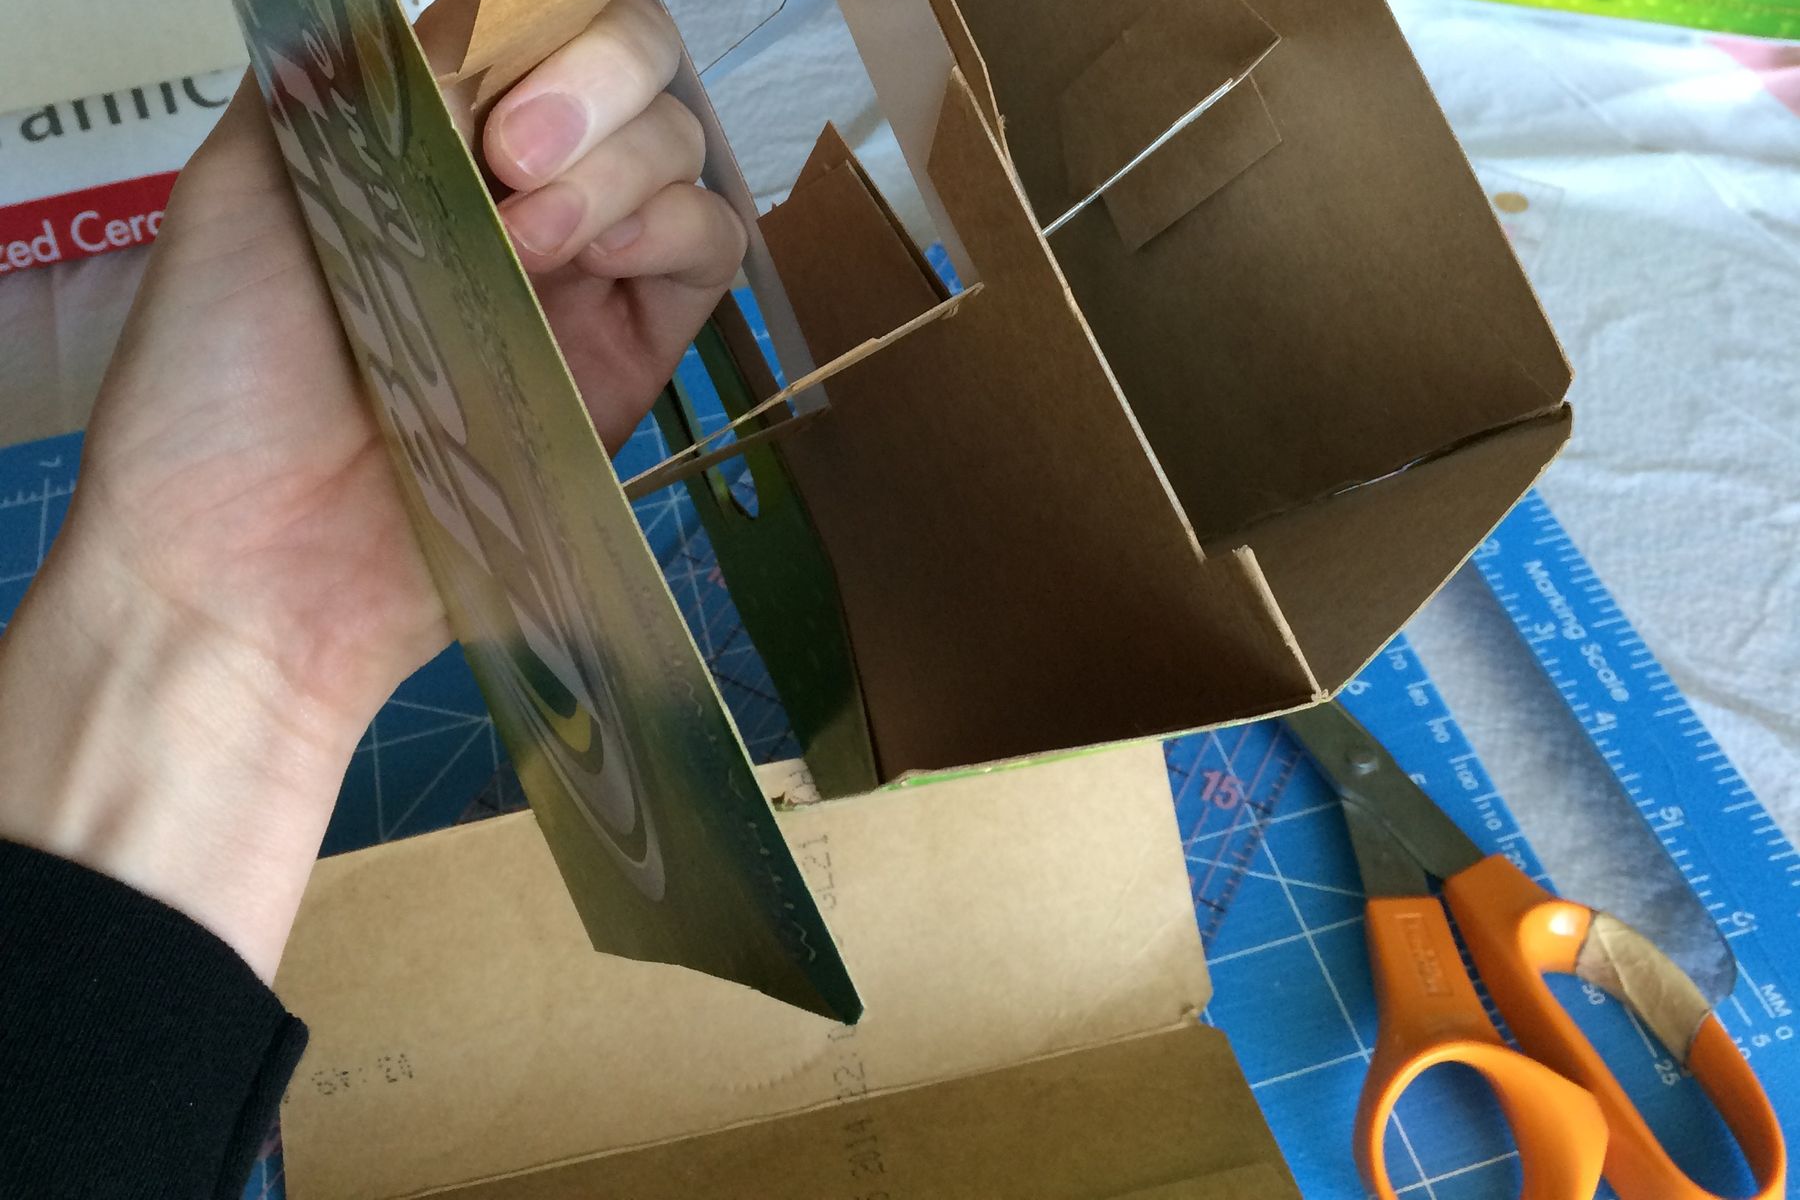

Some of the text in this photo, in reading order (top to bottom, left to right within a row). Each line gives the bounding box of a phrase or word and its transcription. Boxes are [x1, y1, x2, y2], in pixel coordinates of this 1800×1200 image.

[301, 28, 425, 259] Lime
[1580, 643, 1630, 702] Scale
[1202, 770, 1244, 810] 15
[1760, 983, 1793, 1018] MM
